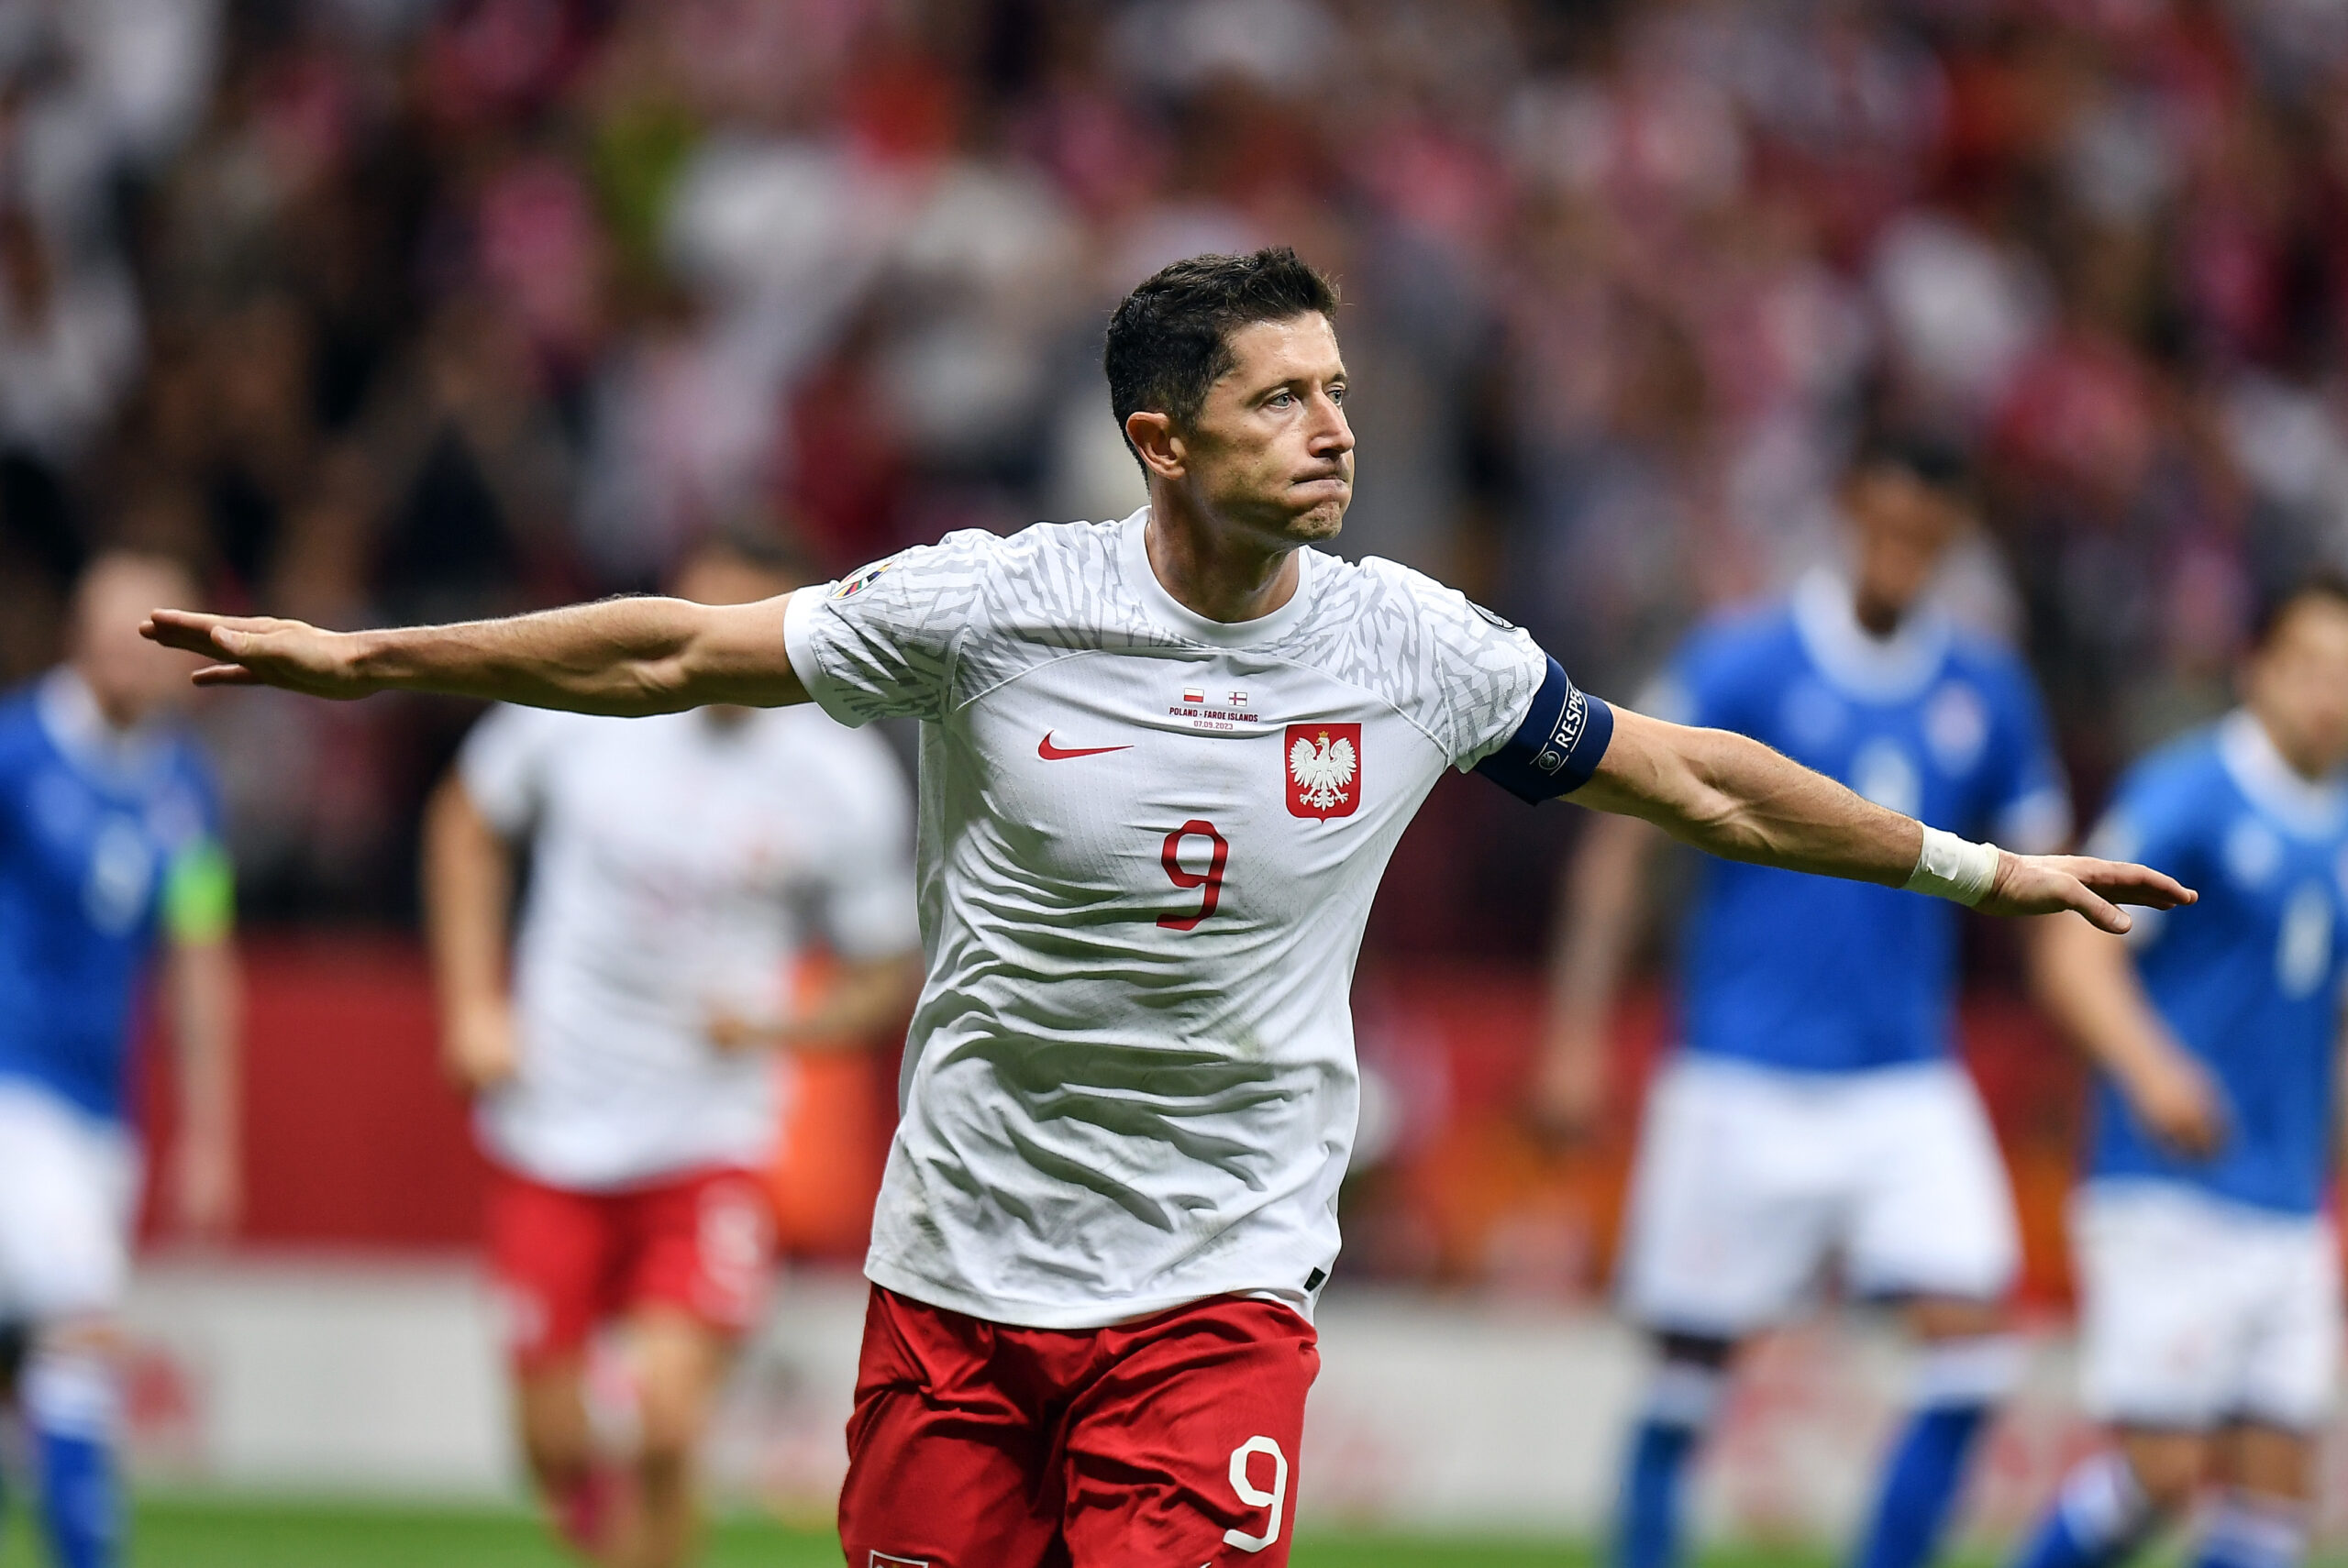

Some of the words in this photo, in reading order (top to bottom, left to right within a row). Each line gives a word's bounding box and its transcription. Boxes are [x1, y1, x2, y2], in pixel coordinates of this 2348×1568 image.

[1169, 707, 1198, 717] POLAND
[1203, 711, 1226, 720] FAROE
[1227, 712, 1258, 722] ISLANDS
[1193, 721, 1233, 730] 07.09.2023
[1556, 679, 1583, 748] RESPEC
[1157, 820, 1229, 931] 9
[1223, 1435, 1288, 1553] 9
